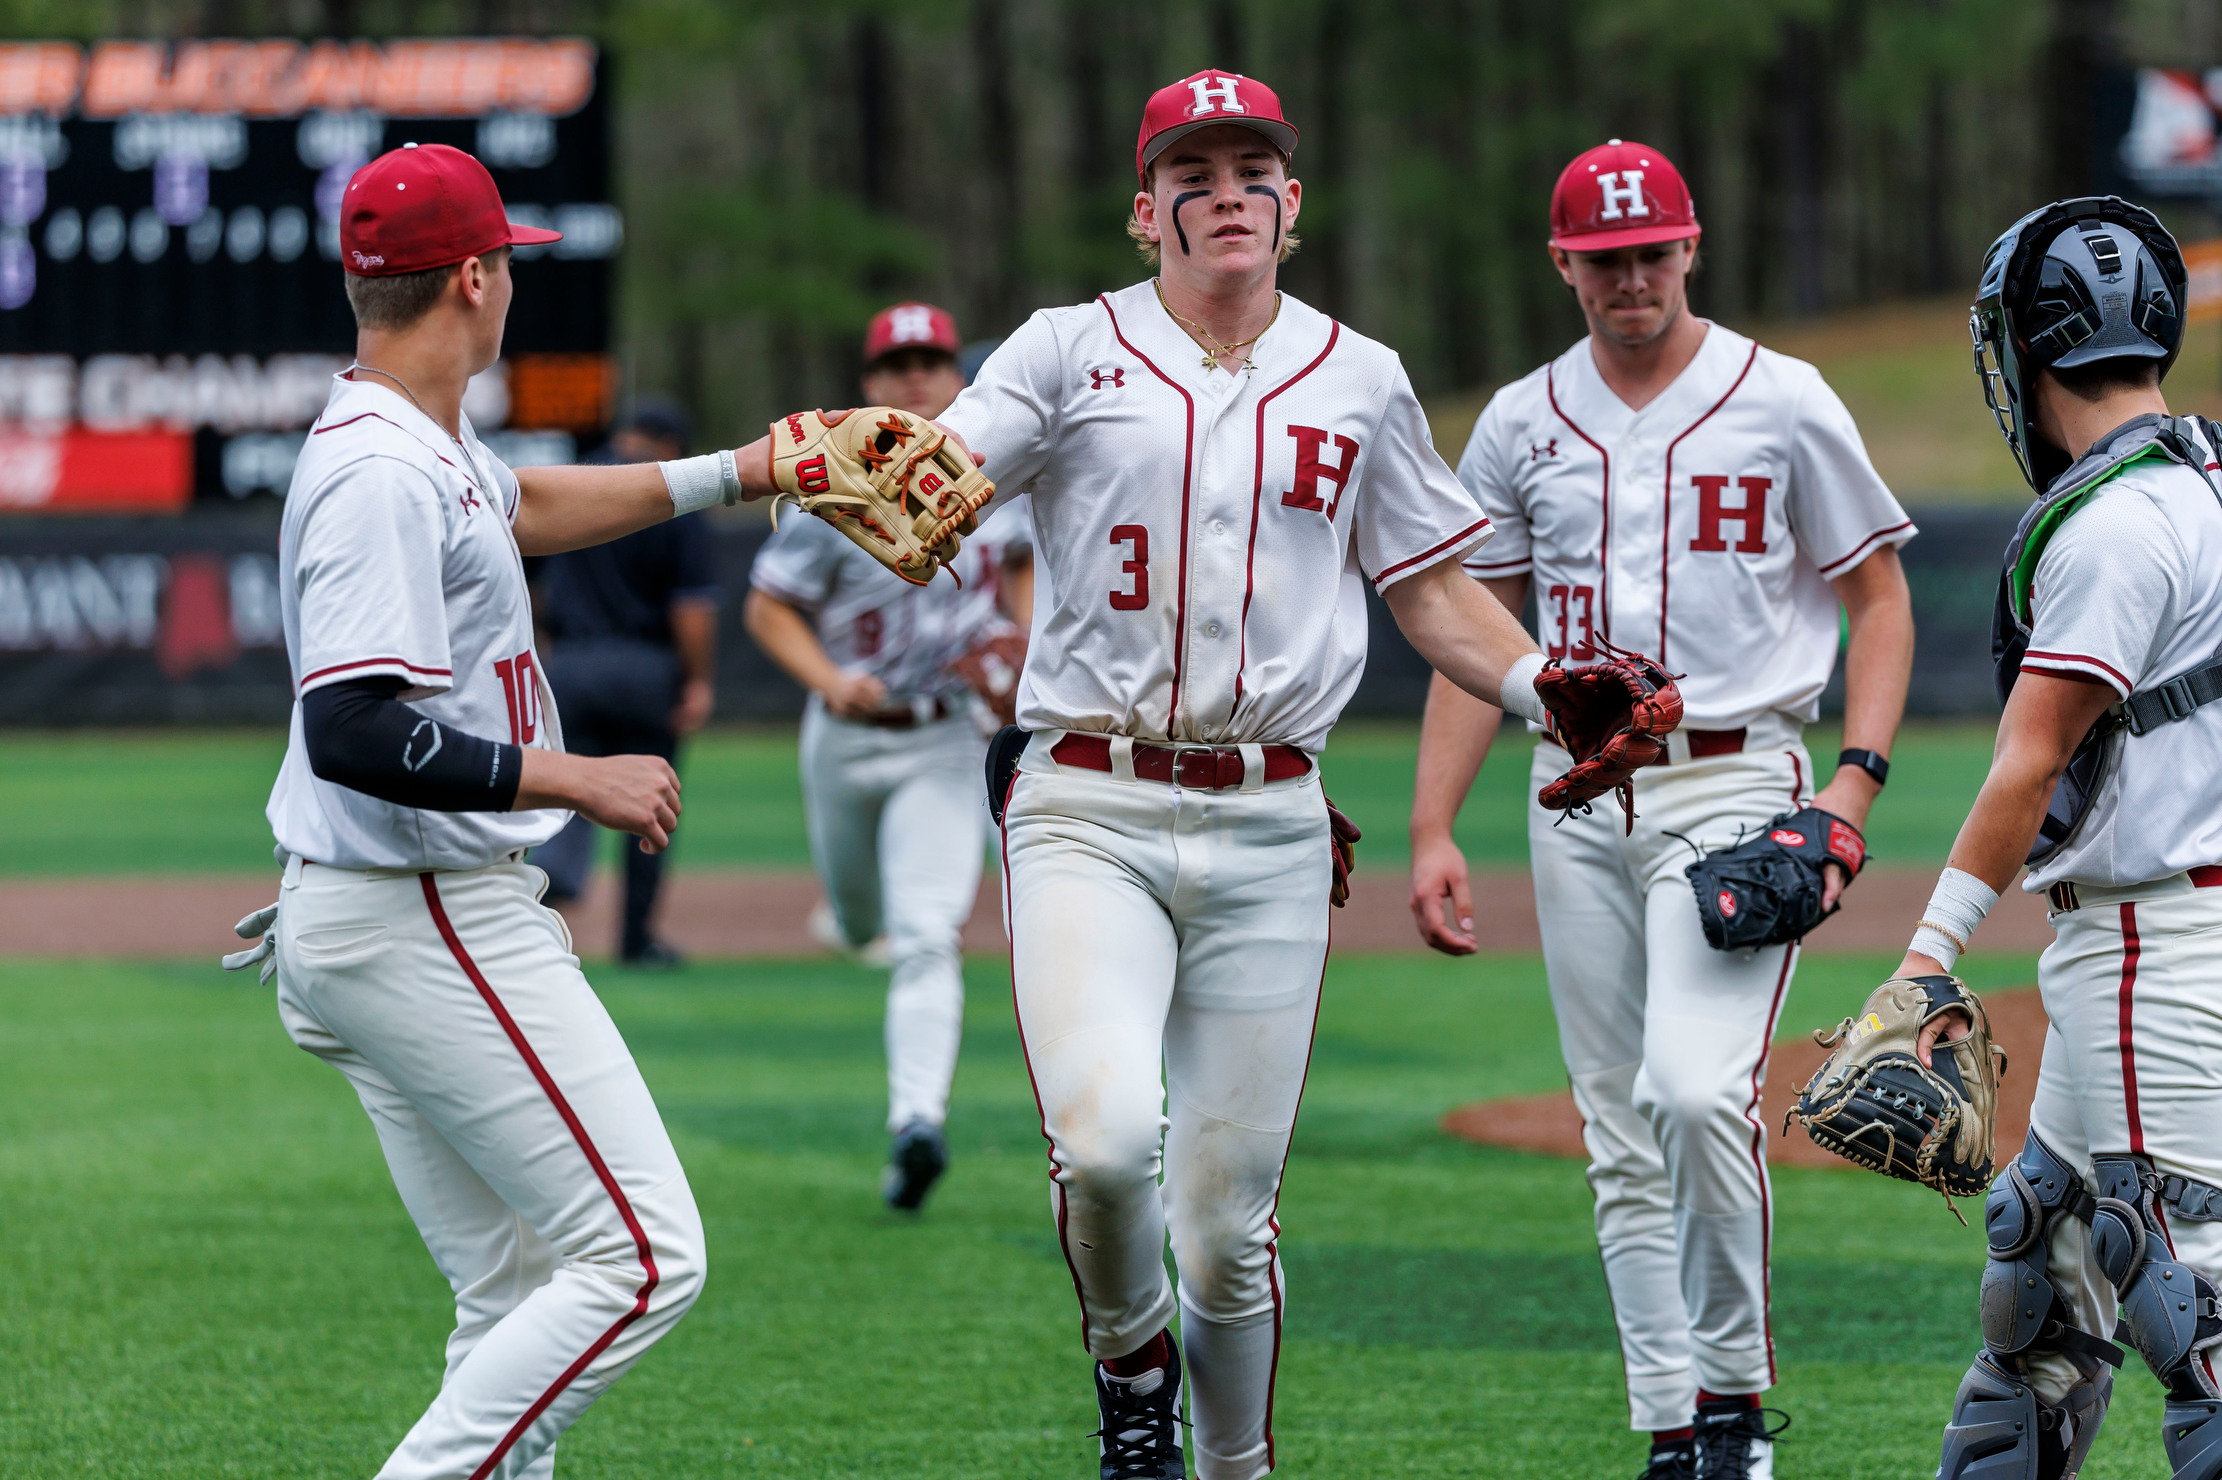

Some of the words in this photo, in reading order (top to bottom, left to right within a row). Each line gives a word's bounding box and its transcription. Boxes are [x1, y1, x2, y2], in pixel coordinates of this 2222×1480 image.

[1188, 77, 1244, 116] H
[1597, 170, 1649, 220] H
[1281, 424, 1360, 524] H
[1689, 475, 1772, 554] H
[1109, 525, 1149, 611] 3
[1548, 585, 1596, 661] 33
[494, 649, 537, 746] 10
